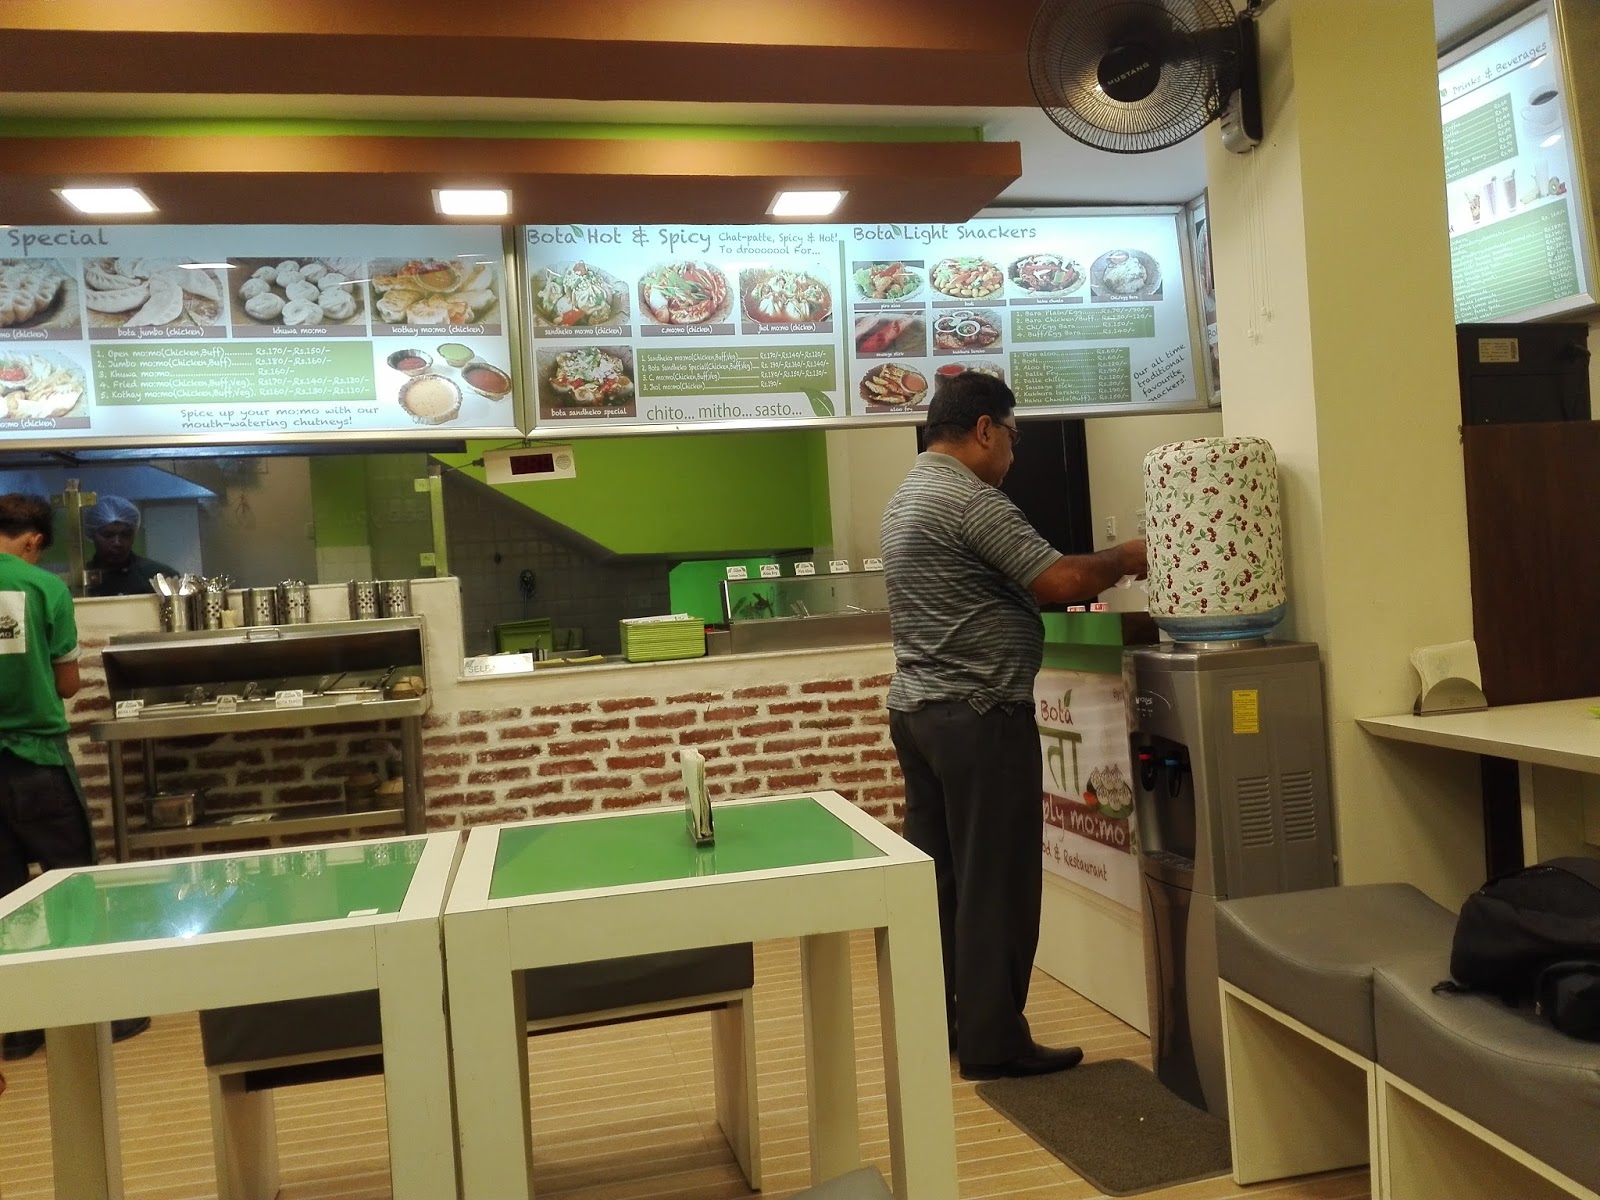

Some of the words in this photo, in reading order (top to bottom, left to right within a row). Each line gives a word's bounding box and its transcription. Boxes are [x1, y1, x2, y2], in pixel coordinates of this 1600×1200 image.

[1496, 41, 1547, 73] Beverages
[1107, 62, 1150, 86] MUSTANG
[8, 228, 109, 256] Special
[527, 226, 577, 244] Bota
[587, 227, 622, 244] Hot
[632, 226, 650, 247] &
[659, 229, 711, 253] Spicy
[718, 232, 775, 246] Chat-patte,
[779, 233, 803, 248] Spicy
[819, 232, 838, 242] Hot!
[853, 225, 895, 240] Bota
[904, 225, 948, 245] Light
[957, 225, 1036, 240] Snackers
[719, 245, 733, 254] To
[118, 328, 136, 337] bota
[138, 328, 164, 339] jumbo
[166, 327, 205, 338] (chicken)
[272, 326, 298, 334] khuwa
[1133, 367, 1148, 380] Our
[1151, 357, 1164, 368] all
[1165, 344, 1185, 359] time
[1137, 355, 1185, 388] traditional
[1142, 368, 1182, 398] favourite
[181, 410, 214, 421] Spice
[219, 410, 234, 420] up
[240, 410, 269, 420] your
[276, 408, 320, 416] mo:mo
[325, 406, 352, 414] with
[182, 418, 288, 430] mouth-watering
[294, 416, 352, 429] chutneys!
[604, 408, 627, 418] special
[647, 405, 694, 421] chito...
[699, 402, 752, 418] mitho...
[756, 402, 802, 416] sasto...
[1041, 699, 1074, 726] Bota
[1070, 809, 1126, 846] mo:mo
[1053, 845, 1061, 863] &
[1064, 850, 1108, 882] Restaurant
